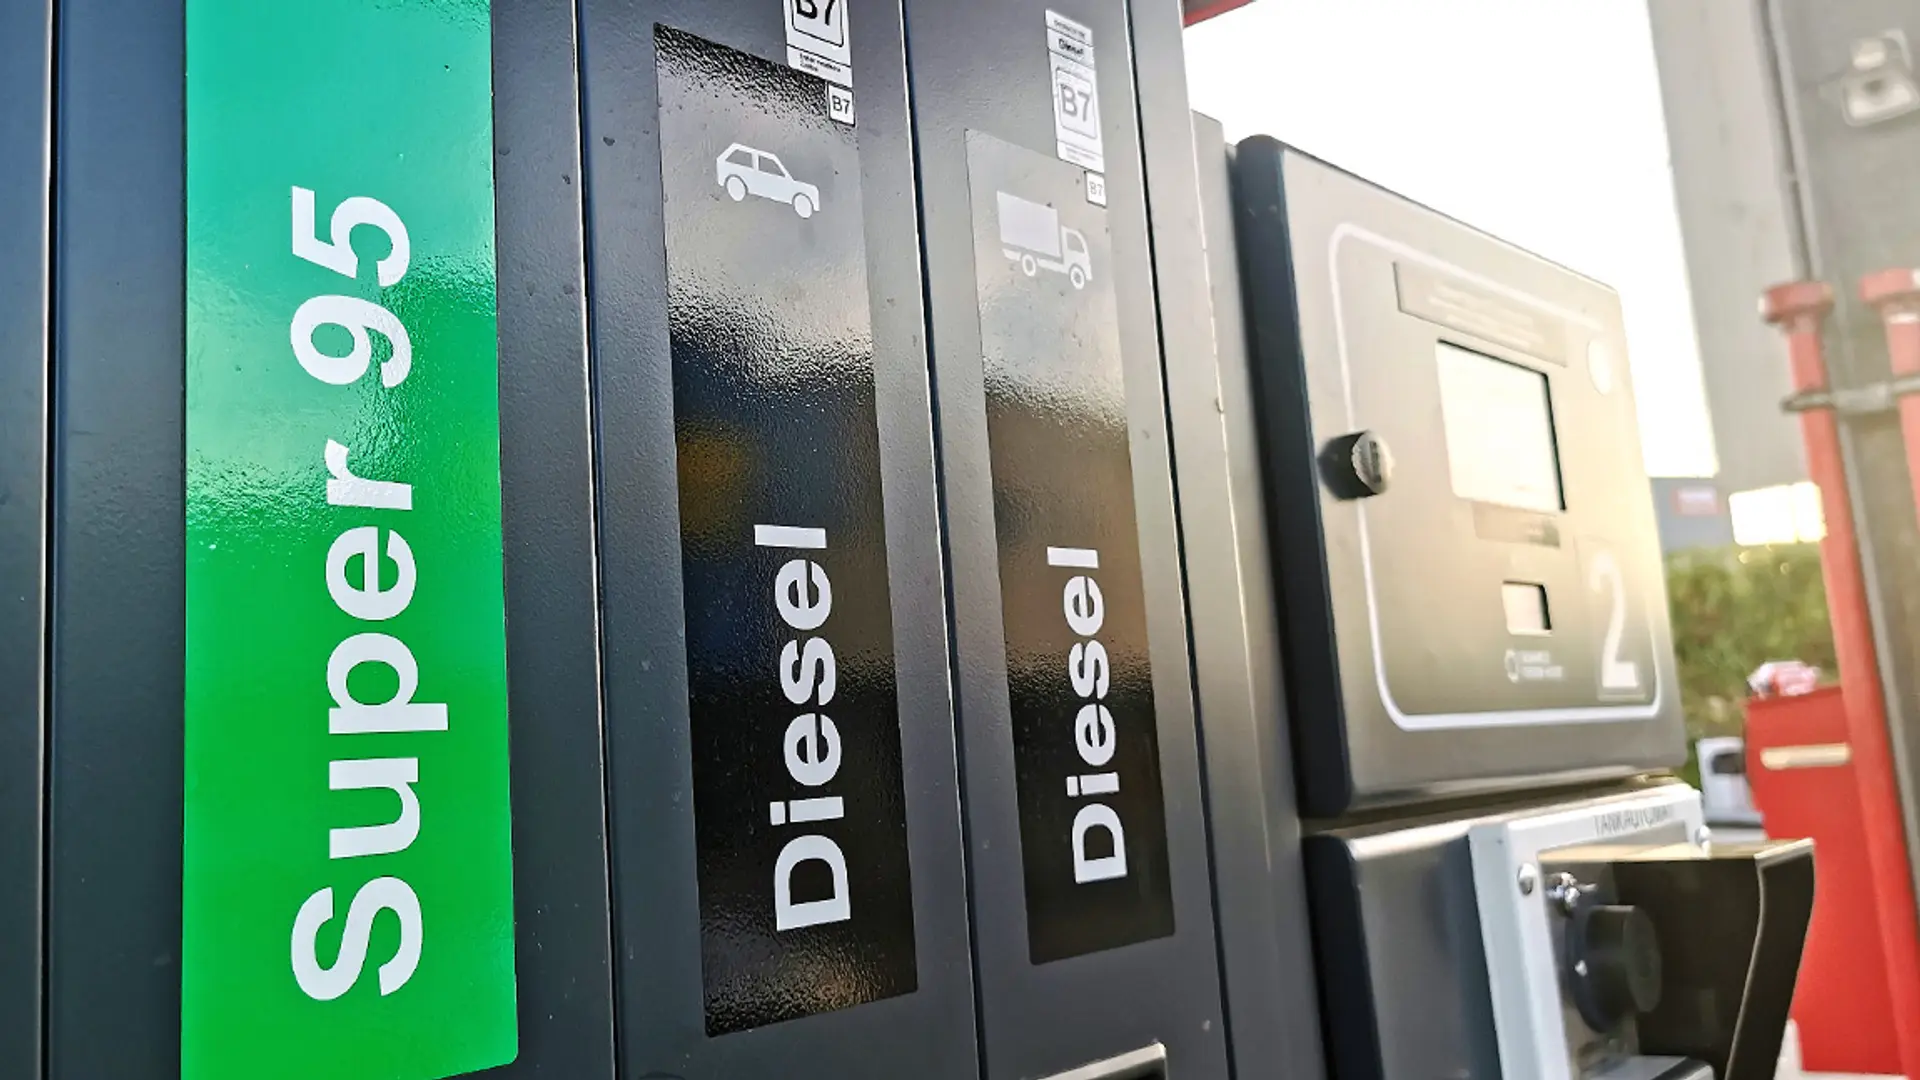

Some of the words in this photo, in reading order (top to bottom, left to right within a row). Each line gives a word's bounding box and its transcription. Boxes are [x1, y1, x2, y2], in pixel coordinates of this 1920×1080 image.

[832, 95, 850, 114] B7
[1060, 83, 1091, 122] B7
[1089, 180, 1103, 196] B7
[290, 186, 411, 388] 95
[1592, 555, 1638, 688] 2
[290, 438, 449, 1001] Super
[754, 524, 851, 931] Diesel
[1046, 546, 1128, 884] Diesel
